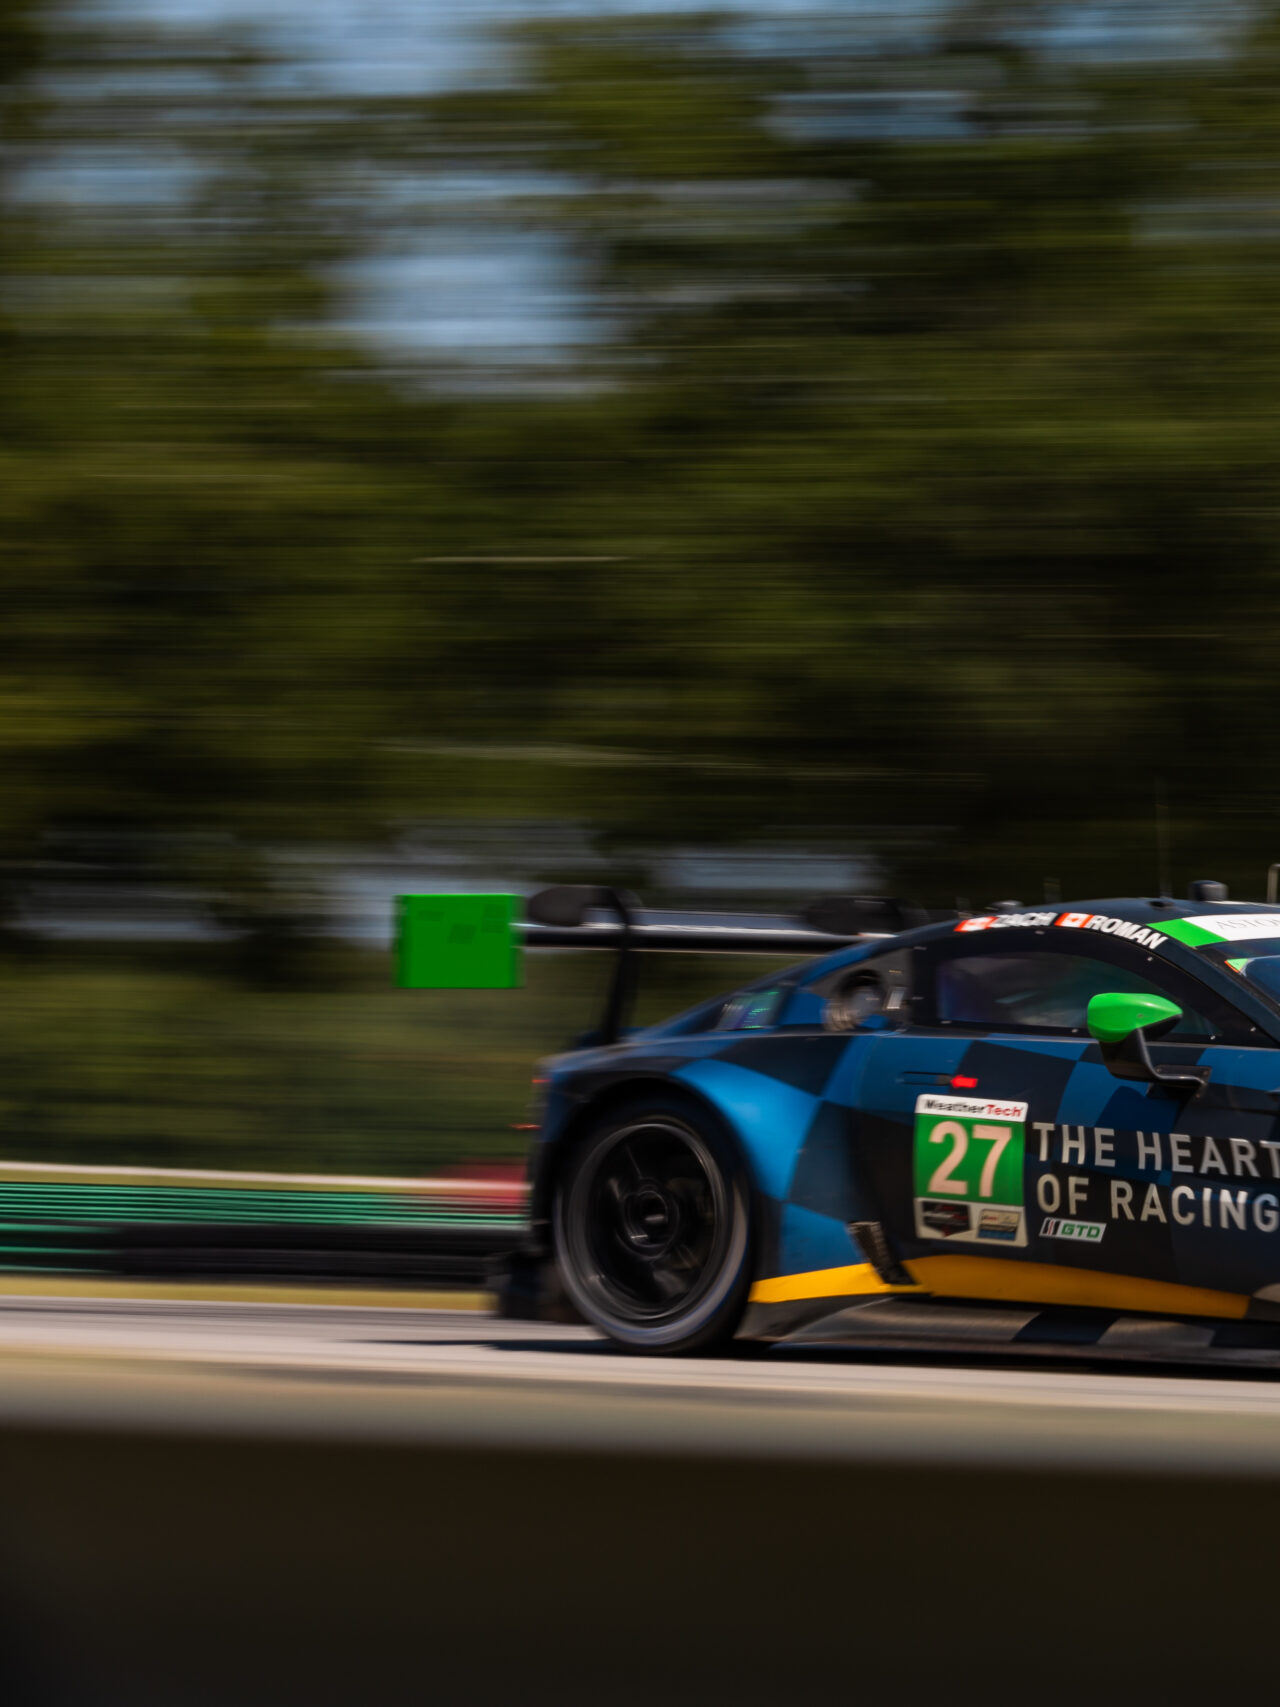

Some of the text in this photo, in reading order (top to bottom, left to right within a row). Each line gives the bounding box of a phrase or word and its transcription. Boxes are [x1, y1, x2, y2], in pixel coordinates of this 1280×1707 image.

[1085, 914, 1169, 950] ROMAN
[927, 1120, 1013, 1198] 27
[1032, 1121, 1117, 1168] THE
[1036, 1173, 1280, 1233] OF RACING
[1060, 1222, 1101, 1239] GTD
